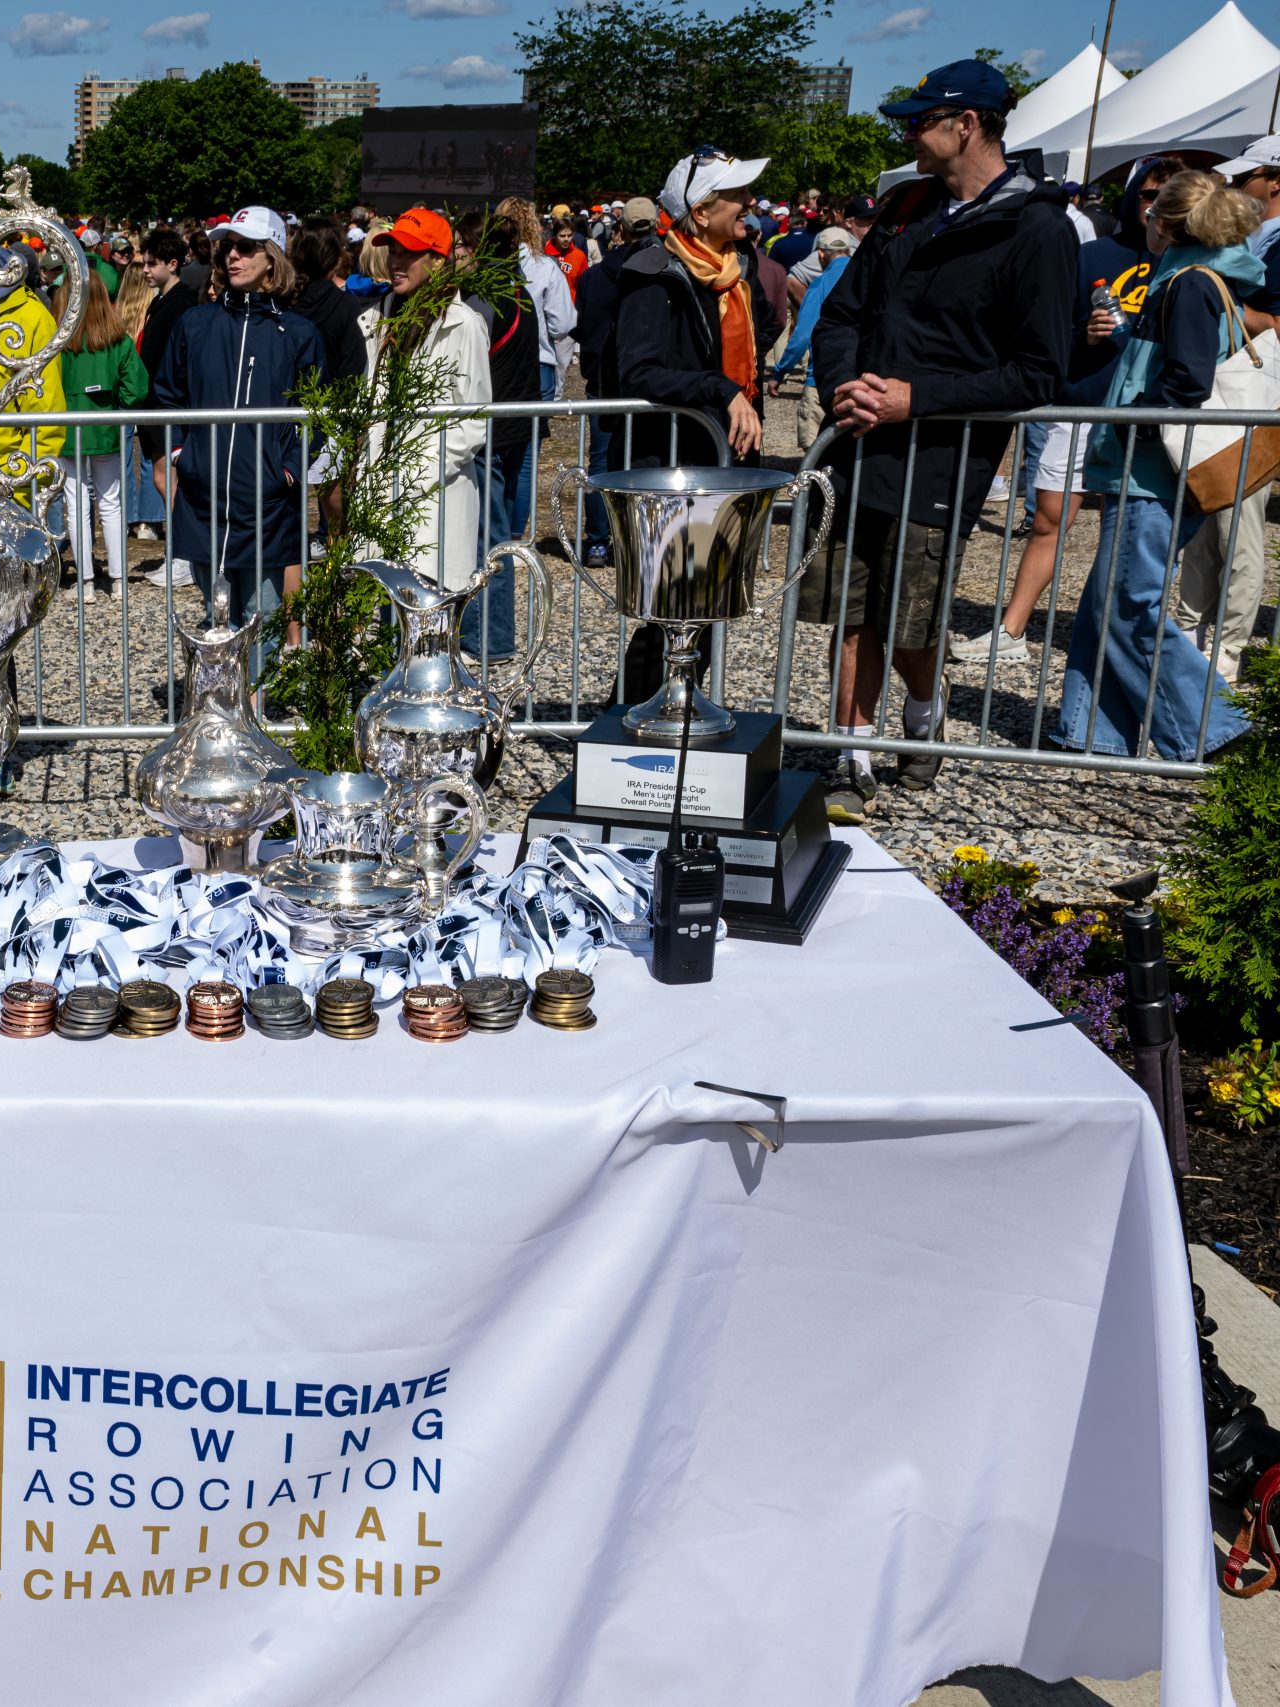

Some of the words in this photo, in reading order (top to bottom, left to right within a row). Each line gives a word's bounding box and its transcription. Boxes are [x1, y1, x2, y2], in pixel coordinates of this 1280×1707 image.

[1110, 263, 1150, 313] Ca
[627, 780, 642, 788] IRA
[689, 785, 706, 795] Cup
[654, 765, 675, 774] IRA
[620, 797, 647, 807] Overall
[648, 799, 671, 809] Points
[633, 790, 655, 799] Men's
[657, 791, 699, 803] Lighteight
[27, 1364, 450, 1417] INTERCOLLEGIATE
[27, 1408, 444, 1463] ROWING
[23, 1457, 442, 1511] ASSOCIATION
[25, 1506, 442, 1555] NATIONAL
[23, 1554, 441, 1601] CHAMPIONSHIP
